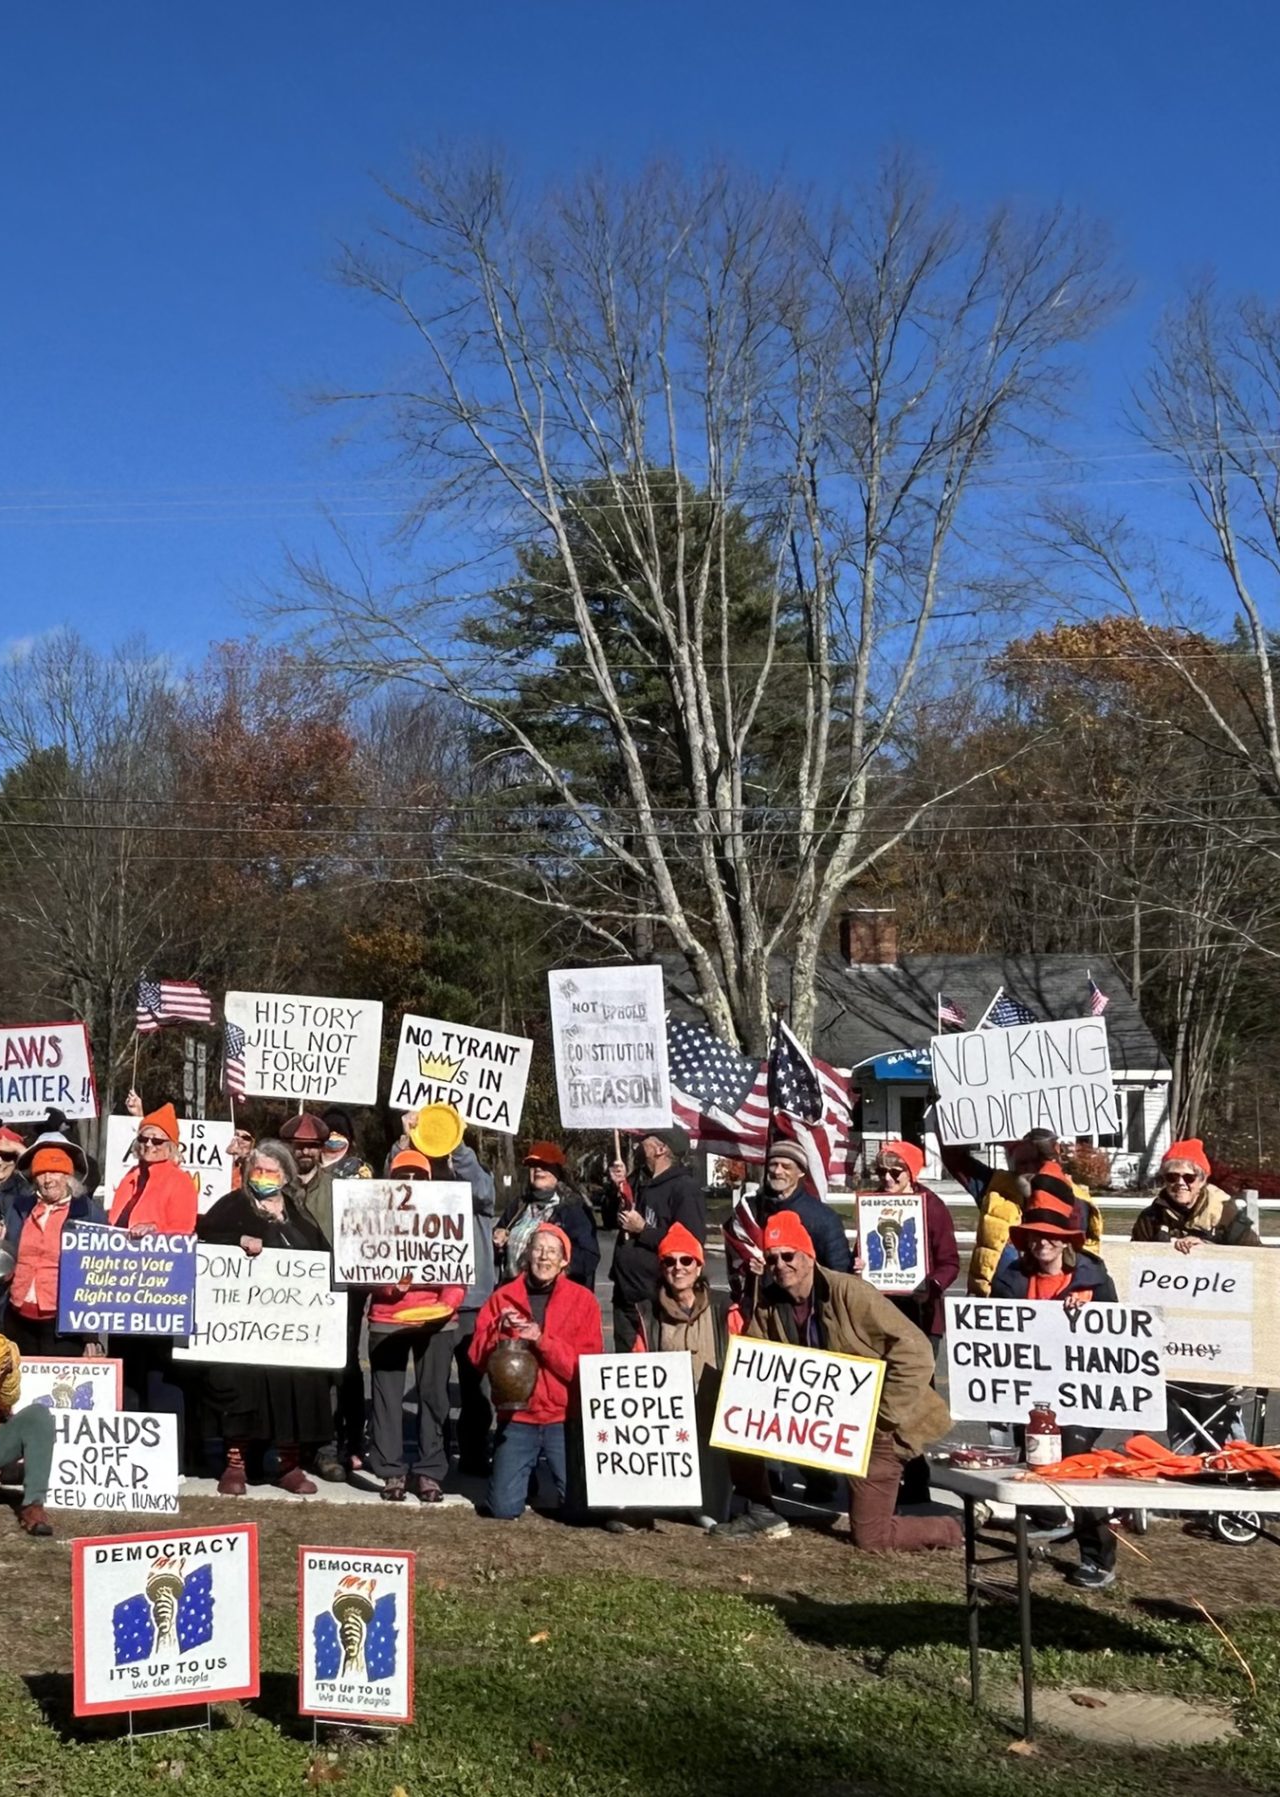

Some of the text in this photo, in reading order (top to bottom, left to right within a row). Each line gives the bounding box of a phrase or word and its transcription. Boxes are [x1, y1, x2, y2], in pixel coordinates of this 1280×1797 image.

[254, 1000, 363, 1030] HISTORY
[572, 1001, 599, 1014] NOT
[307, 1032, 358, 1055] NOT
[405, 1024, 520, 1066] NO TYRANT
[566, 1042, 656, 1062] CONSTITUTION
[261, 1050, 351, 1077] FORGIVE
[932, 1032, 989, 1087] NO
[255, 1071, 338, 1096] TRUMP
[479, 1067, 503, 1093] IN
[568, 1075, 663, 1108] TREASON
[396, 1078, 511, 1128] AMERICA
[190, 1123, 206, 1139] IS
[939, 1096, 980, 1142] NO
[61, 1231, 198, 1253] DEMOCRACY
[360, 1240, 470, 1263] GO HUNGRY
[80, 1255, 174, 1273] Right to Vote
[339, 1264, 418, 1282] WITHOUT
[84, 1271, 170, 1288] Rule of Law
[1137, 1268, 1237, 1298] People
[73, 1287, 189, 1306] Right to Choose
[211, 1286, 336, 1308] THE POOR AS
[69, 1310, 185, 1333] VOTE BLUE
[953, 1303, 1154, 1338] KEEP YOUR
[193, 1320, 322, 1347] HOSTAGES!
[953, 1341, 1161, 1377] CRUEL HANDS
[1165, 1341, 1222, 1361] oney
[21, 1365, 111, 1376] DEMOCRACY
[600, 1365, 668, 1391] FEED
[732, 1347, 873, 1397] HUNGRY
[773, 1386, 836, 1418] FOR
[968, 1377, 1033, 1405] OFF
[589, 1395, 684, 1420] PEOPLE
[54, 1413, 161, 1448] HANDS
[614, 1424, 670, 1446] NOT
[723, 1405, 860, 1458] CHANGE
[82, 1446, 130, 1466] OFF
[596, 1450, 693, 1478] PROFITS
[58, 1459, 149, 1490] S.N.A.P.
[45, 1488, 87, 1508] FEED
[93, 1491, 127, 1511] OUR
[94, 1536, 240, 1565] DEMOCRACY
[307, 1558, 405, 1576] DEMOCRACY
[109, 1657, 228, 1681] IT'S UP TO US
[131, 1678, 149, 1690] We
[339, 1684, 356, 1694] UP
[357, 1685, 373, 1695] TO
[376, 1687, 392, 1696] US
